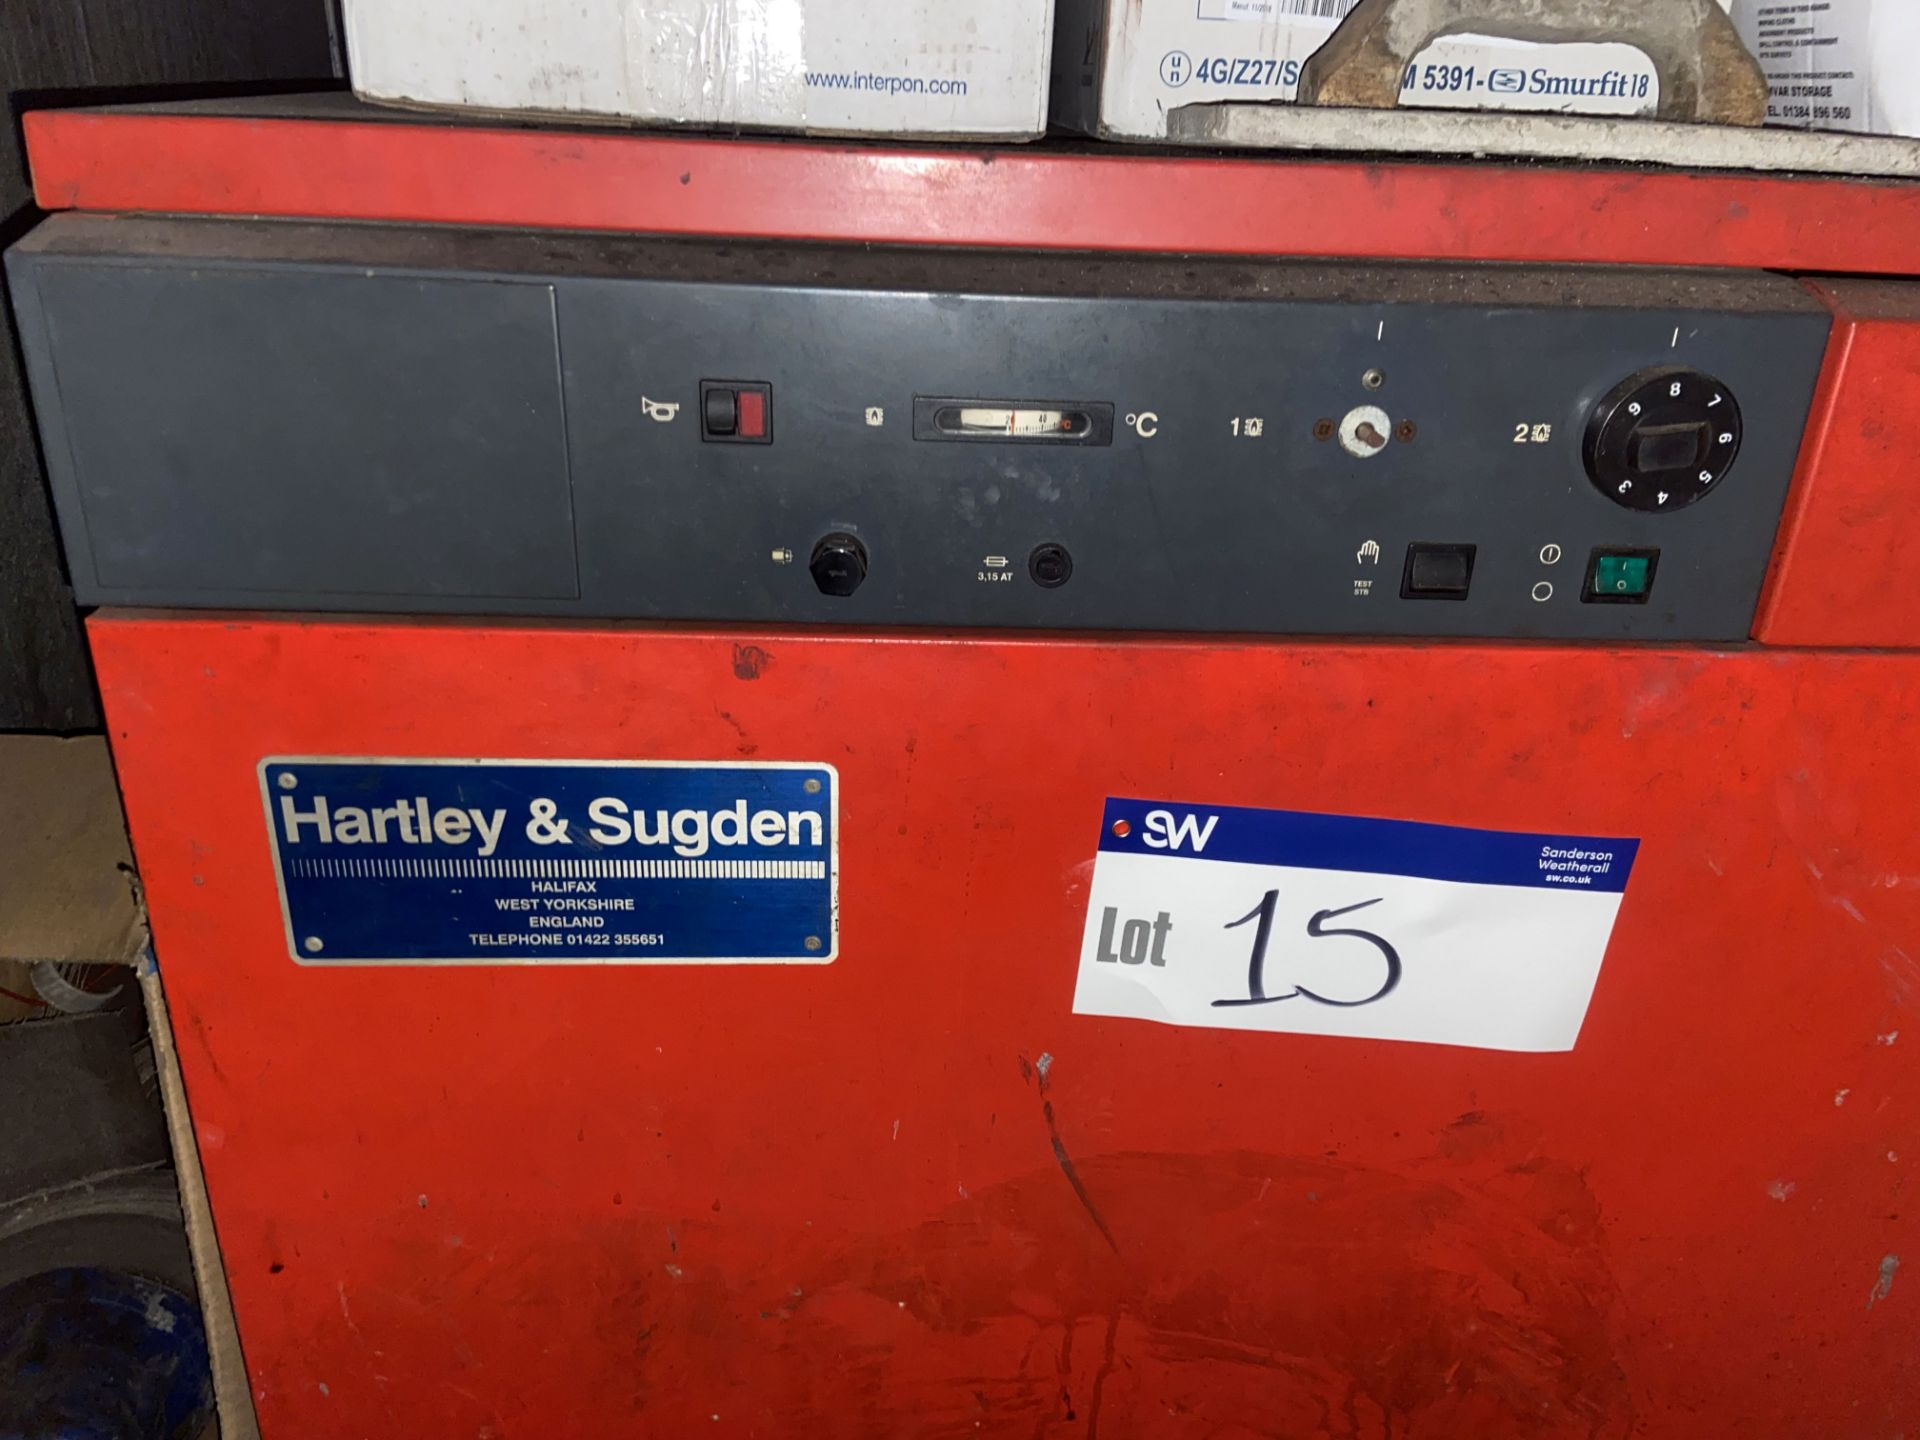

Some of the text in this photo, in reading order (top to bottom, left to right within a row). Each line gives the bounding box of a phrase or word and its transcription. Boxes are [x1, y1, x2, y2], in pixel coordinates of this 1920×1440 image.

[1196, 57, 1299, 87] 4G/Z27/S
[1423, 64, 1484, 92] 5391-
[804, 71, 968, 95] www.interpon.com
[1528, 68, 1628, 98] Smurfit
[1791, 86, 1832, 98] STORAGE
[1767, 105, 1781, 117] EL.
[1783, 105, 1810, 118] 01384
[1833, 106, 1851, 120] 560
[1669, 382, 1681, 397] 8
[1707, 393, 1722, 408] 7
[1230, 417, 1240, 437] 1
[1513, 424, 1528, 443] 2
[1699, 470, 1713, 484] 5
[1618, 479, 1632, 493] 3
[1657, 491, 1669, 505] 4
[977, 572, 1013, 583] 3,15 AT
[1353, 580, 1373, 588] TEST
[280, 796, 824, 858] Hartley & Sugden
[1142, 809, 1219, 852] SW
[1541, 845, 1613, 861] Sanderson
[1538, 858, 1610, 874] Weatherall
[1545, 874, 1592, 885] sw.co.uk
[531, 881, 597, 894] HALIFAX
[495, 898, 635, 912] WEST YORKSHIRE
[529, 916, 604, 929] ENGLAND
[469, 933, 665, 946] TELEPHONE 01422 355651
[1096, 906, 1173, 967] Lot
[1210, 889, 1402, 1008] 15
